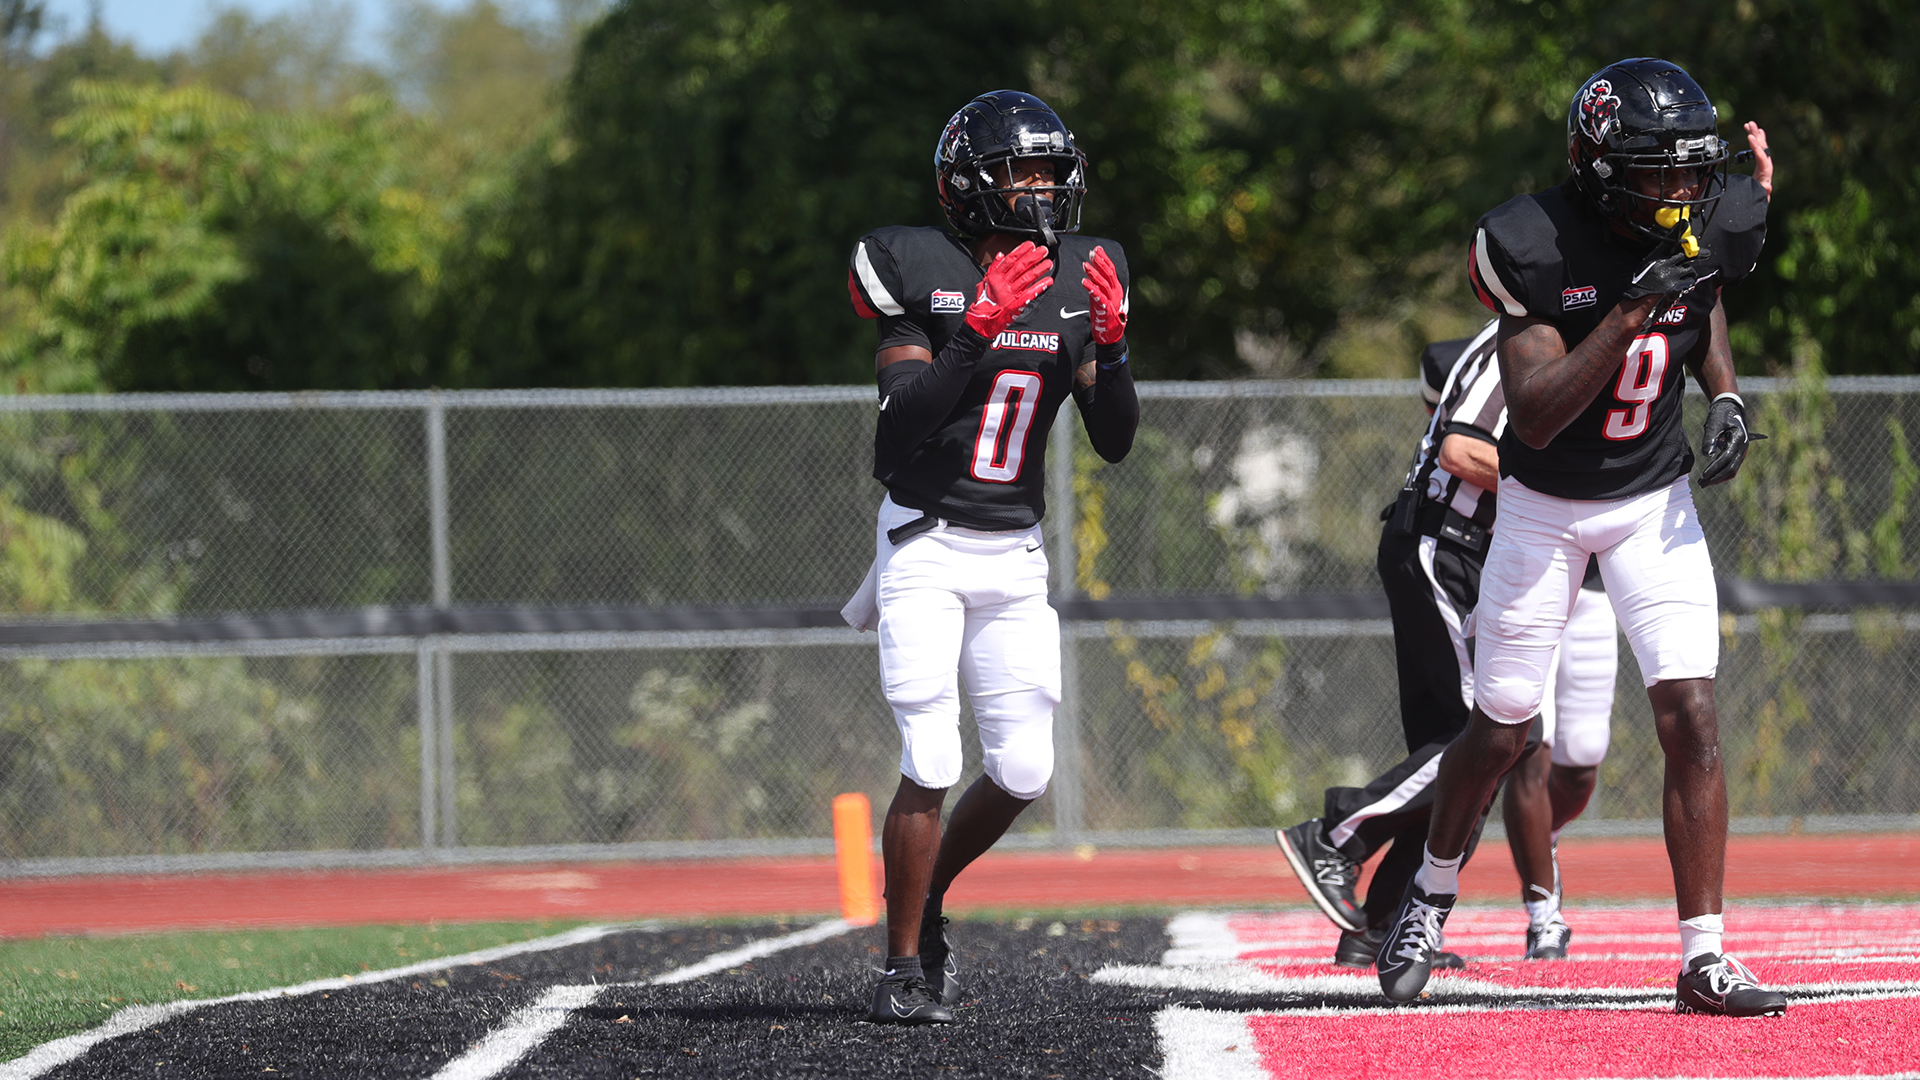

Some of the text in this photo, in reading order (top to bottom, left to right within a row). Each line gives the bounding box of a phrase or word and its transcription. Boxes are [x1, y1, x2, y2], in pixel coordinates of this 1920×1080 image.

[932, 297, 963, 307] PSAC
[1563, 290, 1596, 305] PSAC
[1602, 332, 1669, 440] 9
[970, 369, 1044, 484] 0
